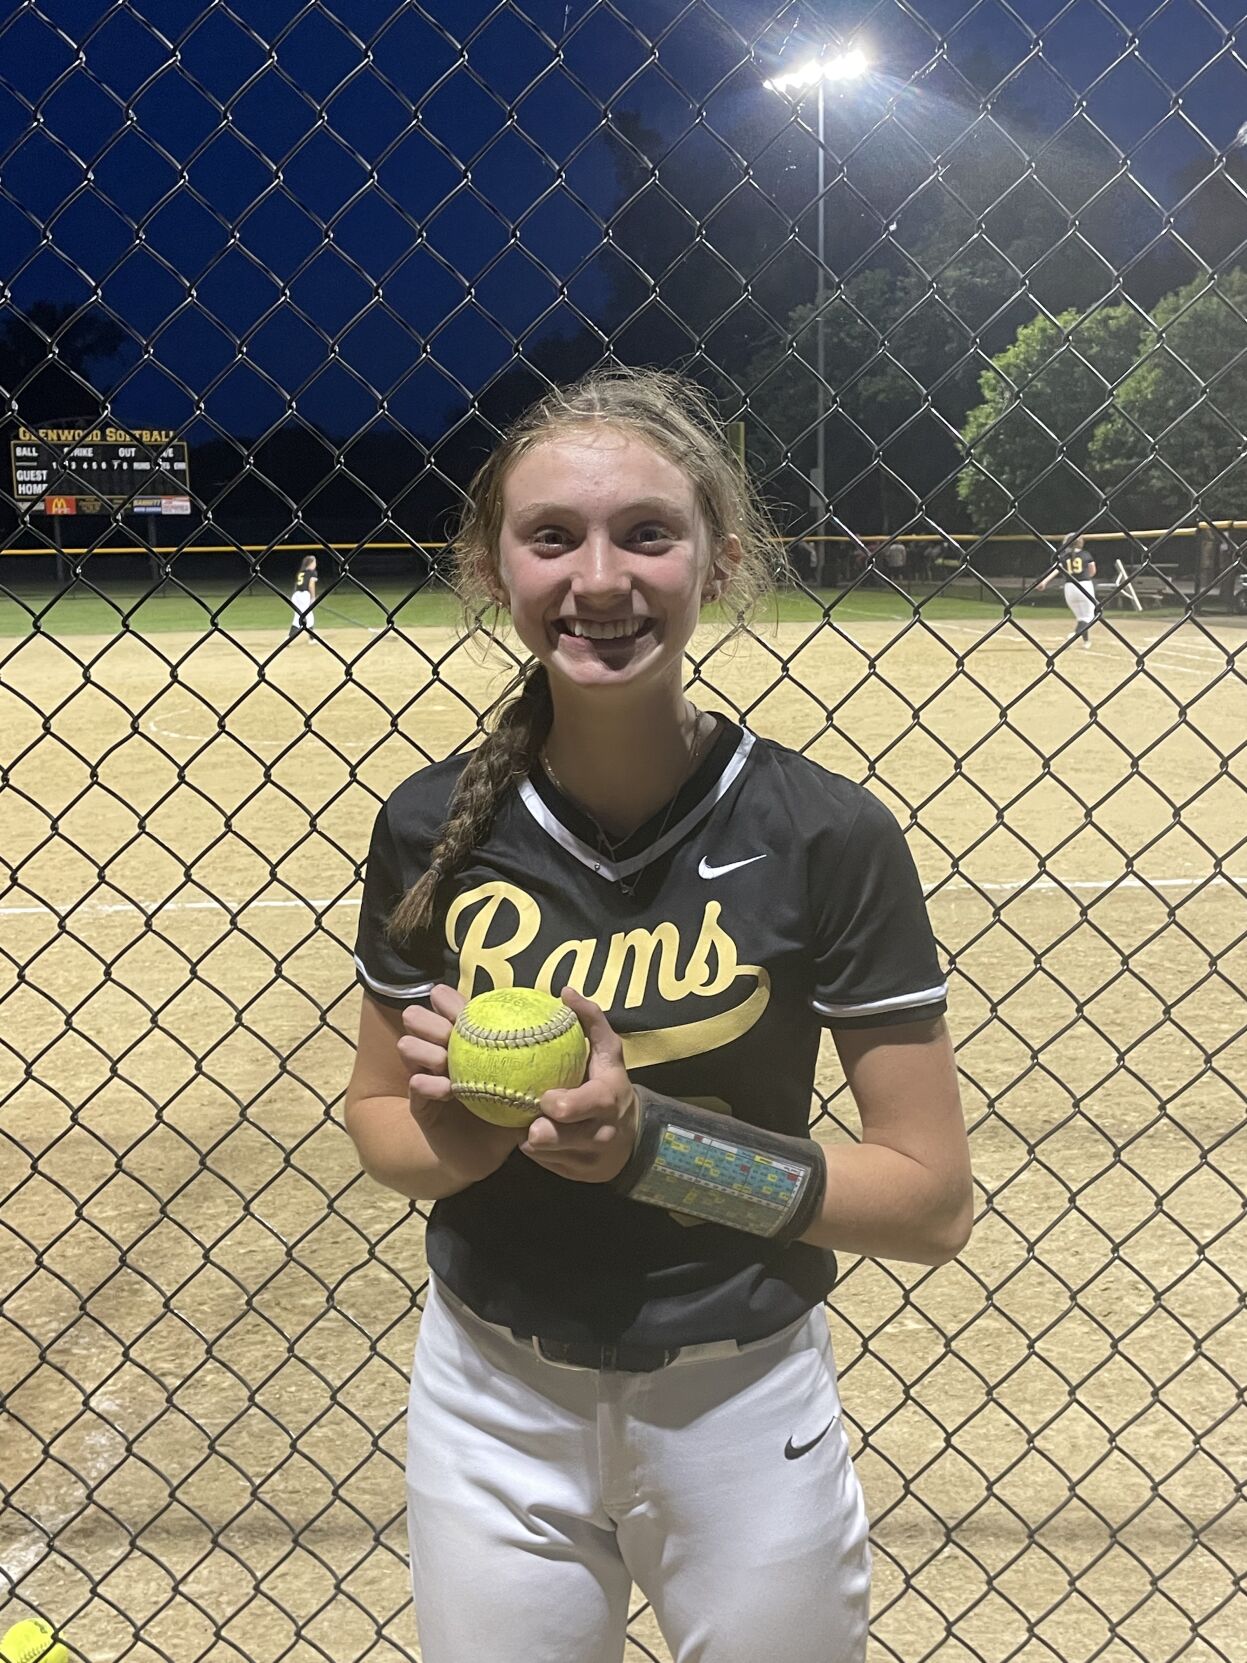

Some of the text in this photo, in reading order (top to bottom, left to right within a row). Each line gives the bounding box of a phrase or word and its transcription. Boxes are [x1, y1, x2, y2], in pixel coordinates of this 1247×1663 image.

[18, 427, 101, 441] GENWOOD
[15, 447, 38, 457] BALL
[63, 447, 94, 457] SRIKE
[118, 447, 136, 457] OUT
[16, 470, 48, 481] GUEST
[1065, 556, 1083, 575] 19
[445, 881, 739, 1013] Rams
